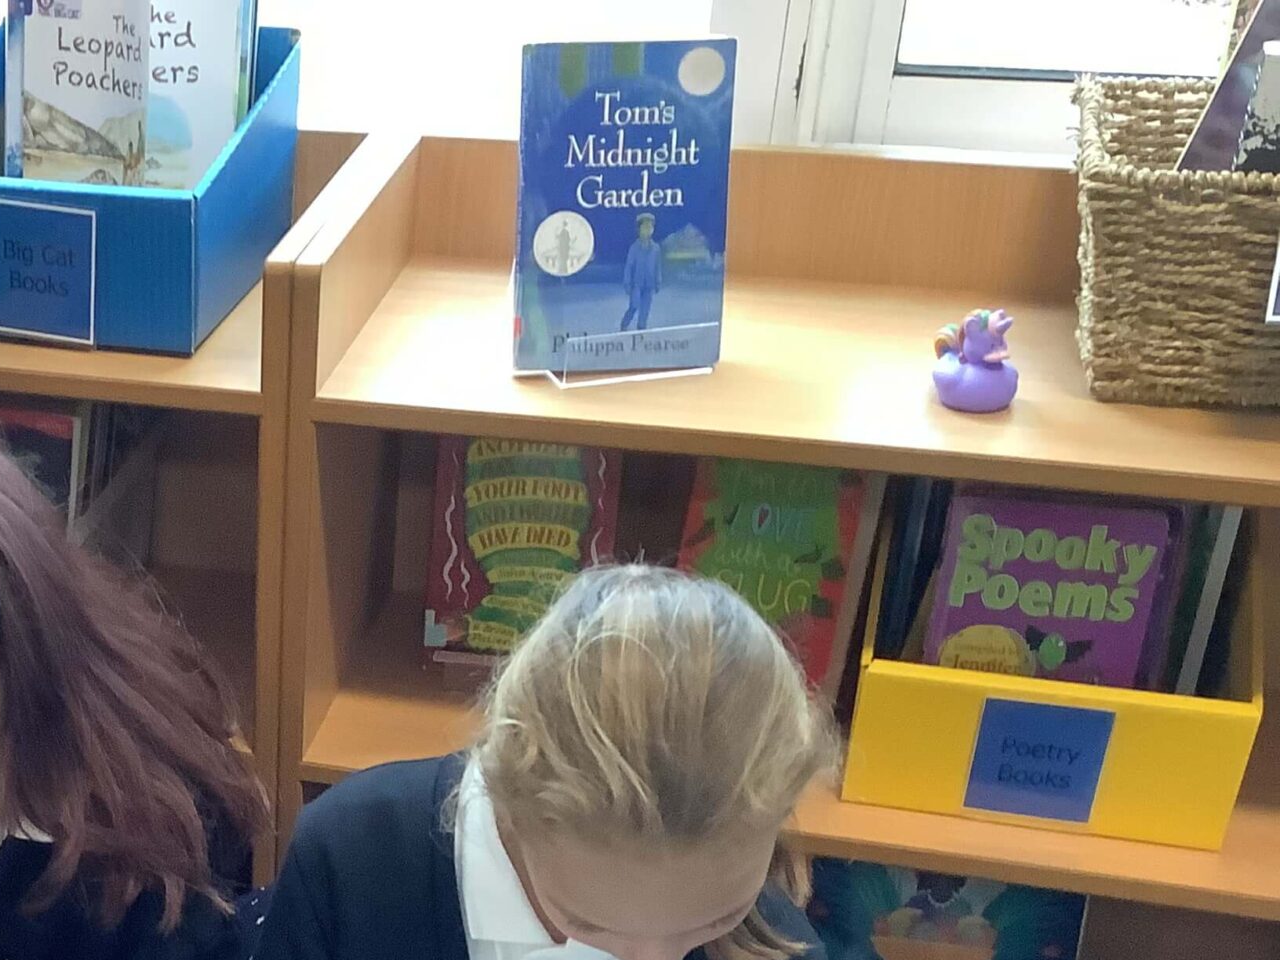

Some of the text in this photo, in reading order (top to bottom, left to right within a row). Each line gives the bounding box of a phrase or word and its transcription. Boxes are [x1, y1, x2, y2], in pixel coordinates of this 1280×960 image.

[113, 15, 136, 37] The
[150, 3, 178, 24] he
[57, 26, 142, 73] Leopard
[52, 60, 143, 101] Poachers
[594, 90, 676, 127] Tom's
[564, 128, 700, 174] Midnight
[575, 169, 685, 209] Garden
[2, 238, 77, 270] Big Cat
[8, 269, 70, 298] Books
[473, 478, 527, 502] YOUR
[960, 512, 1157, 586] Spooky
[948, 557, 1141, 624] Poems
[1001, 735, 1082, 767] Poetry
[996, 762, 1073, 791] Books
